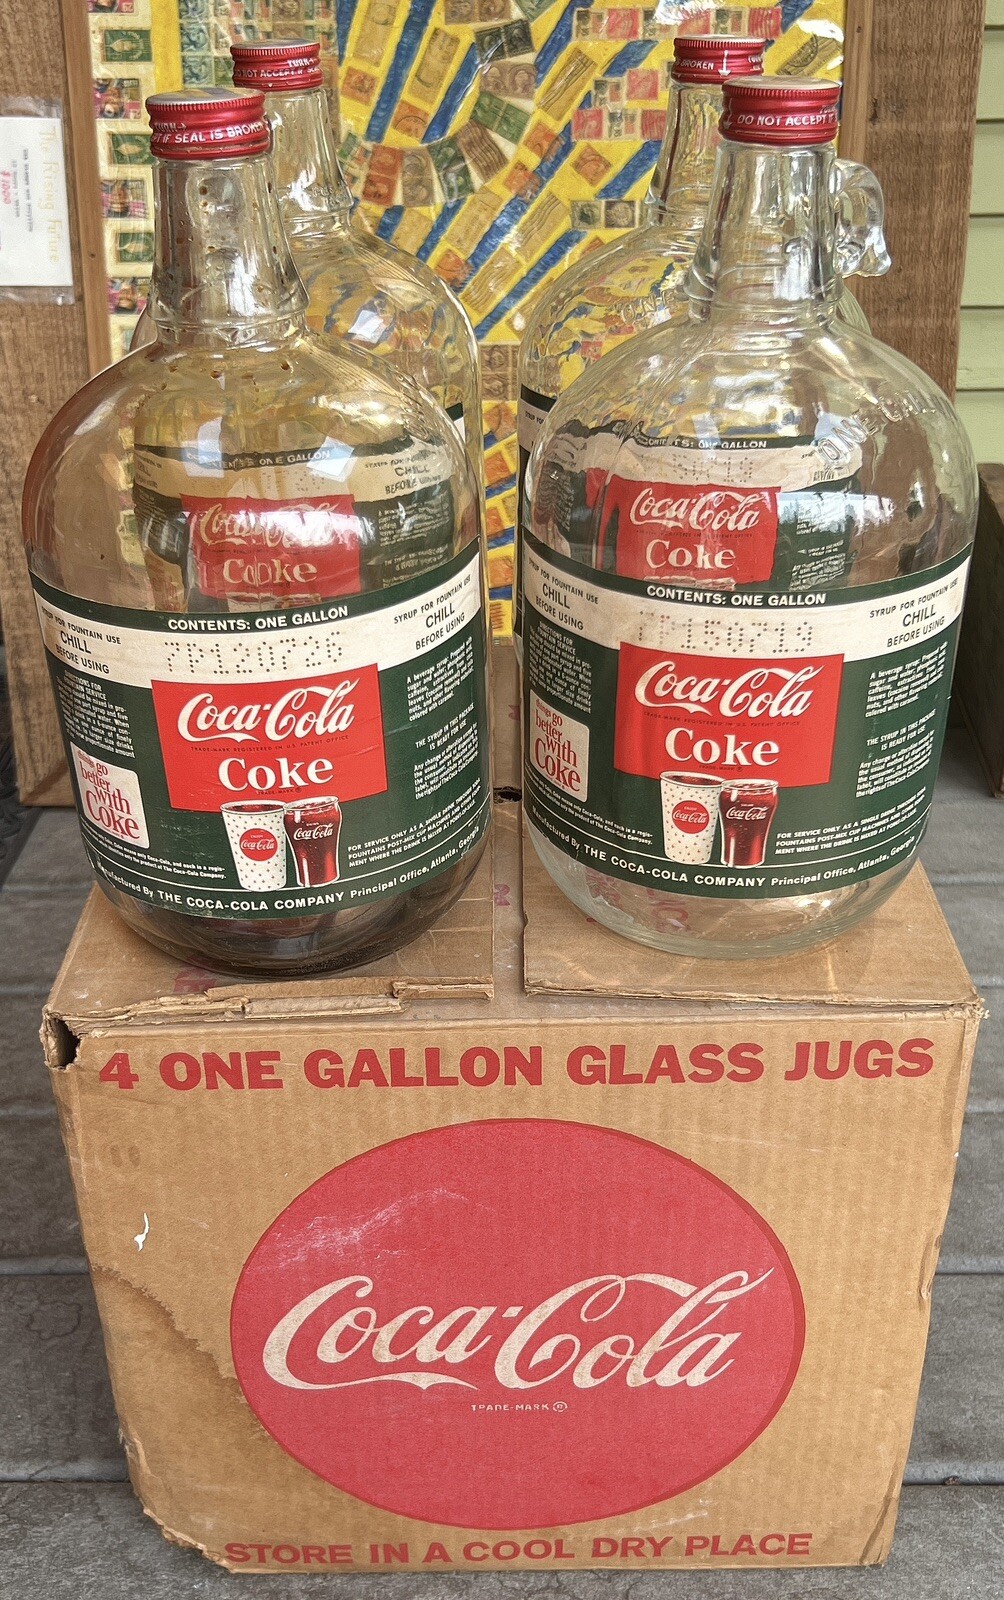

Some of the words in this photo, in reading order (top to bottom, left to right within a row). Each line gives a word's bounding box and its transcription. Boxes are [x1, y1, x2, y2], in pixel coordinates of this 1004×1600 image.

[681, 58, 714, 70] BROKEN
[738, 115, 753, 124] DO
[757, 116, 782, 126] NOT
[785, 114, 826, 125] ACCEPT
[175, 132, 205, 143] SEAL
[210, 128, 223, 140] IS
[722, 440, 766, 448] GALLON
[646, 539, 736, 569] Coke
[540, 569, 550, 580] FOR
[552, 576, 583, 597] FOUNTAIN
[586, 593, 598, 604] USE
[542, 583, 570, 610] CHILL
[646, 586, 727, 605] CONTENTS:
[731, 595, 763, 606] ONE
[768, 593, 826, 606] GALLON
[870, 606, 896, 618] SYRUP
[900, 600, 914, 610] FOR
[918, 584, 948, 605] FOUNTAIN
[168, 619, 250, 631] CONTENTS:
[255, 616, 287, 630] ONE
[292, 606, 348, 626] GALLON
[394, 609, 418, 624] SYRUP
[421, 602, 434, 613] FOR
[436, 583, 462, 605] FOUNTAIN
[426, 602, 455, 628] CHILL
[536, 595, 556, 618] BEFORE
[558, 612, 584, 631] USING
[902, 604, 936, 627] CHILL
[60, 630, 91, 654] CHILL
[68, 622, 102, 640] FOUNTAIN
[106, 635, 121, 644] USE
[416, 628, 444, 650] BEFORE
[446, 612, 465, 633] USING
[887, 629, 920, 648] BEFORE
[922, 616, 945, 635] USING
[56, 644, 79, 664] BEFORE
[81, 657, 109, 674] USING
[634, 660, 825, 718] Coca-Cola
[177, 677, 360, 742] Coca-Cola
[552, 712, 563, 727] go
[326, 734, 349, 743] OFFICE
[415, 739, 426, 748] THE
[428, 729, 443, 742] SYRUP
[535, 709, 562, 742] better
[867, 737, 879, 746] THE
[880, 731, 899, 742] SYRUP
[546, 735, 577, 768] with
[664, 727, 780, 766] Coke
[79, 760, 110, 792] better
[96, 762, 108, 776] go
[218, 757, 334, 791] Coke
[534, 737, 581, 792] Coke
[86, 789, 140, 839] Coke
[94, 786, 132, 815] with
[348, 844, 362, 852] FOR
[364, 836, 389, 848] SERVICE
[391, 830, 407, 840] ONLY
[409, 824, 417, 833] AS
[426, 812, 441, 826] SINGLE
[776, 837, 816, 847] FOUNTAINS
[849, 828, 861, 836] CUP
[794, 828, 821, 838] SERVICE
[823, 825, 841, 834] ONLY
[860, 815, 879, 826] SINGLE
[348, 846, 386, 860] FOUNTAINS
[416, 829, 427, 839] CUP
[350, 858, 367, 867] MENT
[369, 852, 390, 862] WHERE
[392, 849, 402, 857] THE
[796, 845, 819, 853] WHERE
[571, 838, 580, 850] By
[584, 844, 607, 862] THE
[610, 856, 688, 882] COCA-COLA
[694, 875, 766, 887] COMPANY
[771, 873, 821, 886] Principal
[824, 865, 856, 881] Office,
[858, 854, 889, 871] Atlanta,
[143, 885, 154, 897] By
[157, 890, 183, 904] THE
[186, 897, 268, 911] COCA-COLA
[274, 892, 344, 910] COMPANY
[350, 877, 396, 898] Principal
[399, 866, 430, 883] Office,
[430, 848, 458, 869] Atlanta,
[100, 1051, 139, 1090] 4
[158, 1050, 285, 1091] ONE
[302, 1046, 543, 1089] GALLON
[566, 1042, 765, 1087] GLASS
[784, 1038, 935, 1082] JUGS
[262, 1266, 775, 1391] Coca-Cola
[224, 1542, 353, 1565] STORE
[369, 1542, 409, 1564] IN
[422, 1541, 453, 1563] A
[462, 1539, 575, 1562] COOL
[592, 1536, 675, 1559] DRY
[685, 1532, 812, 1556] PLACE
